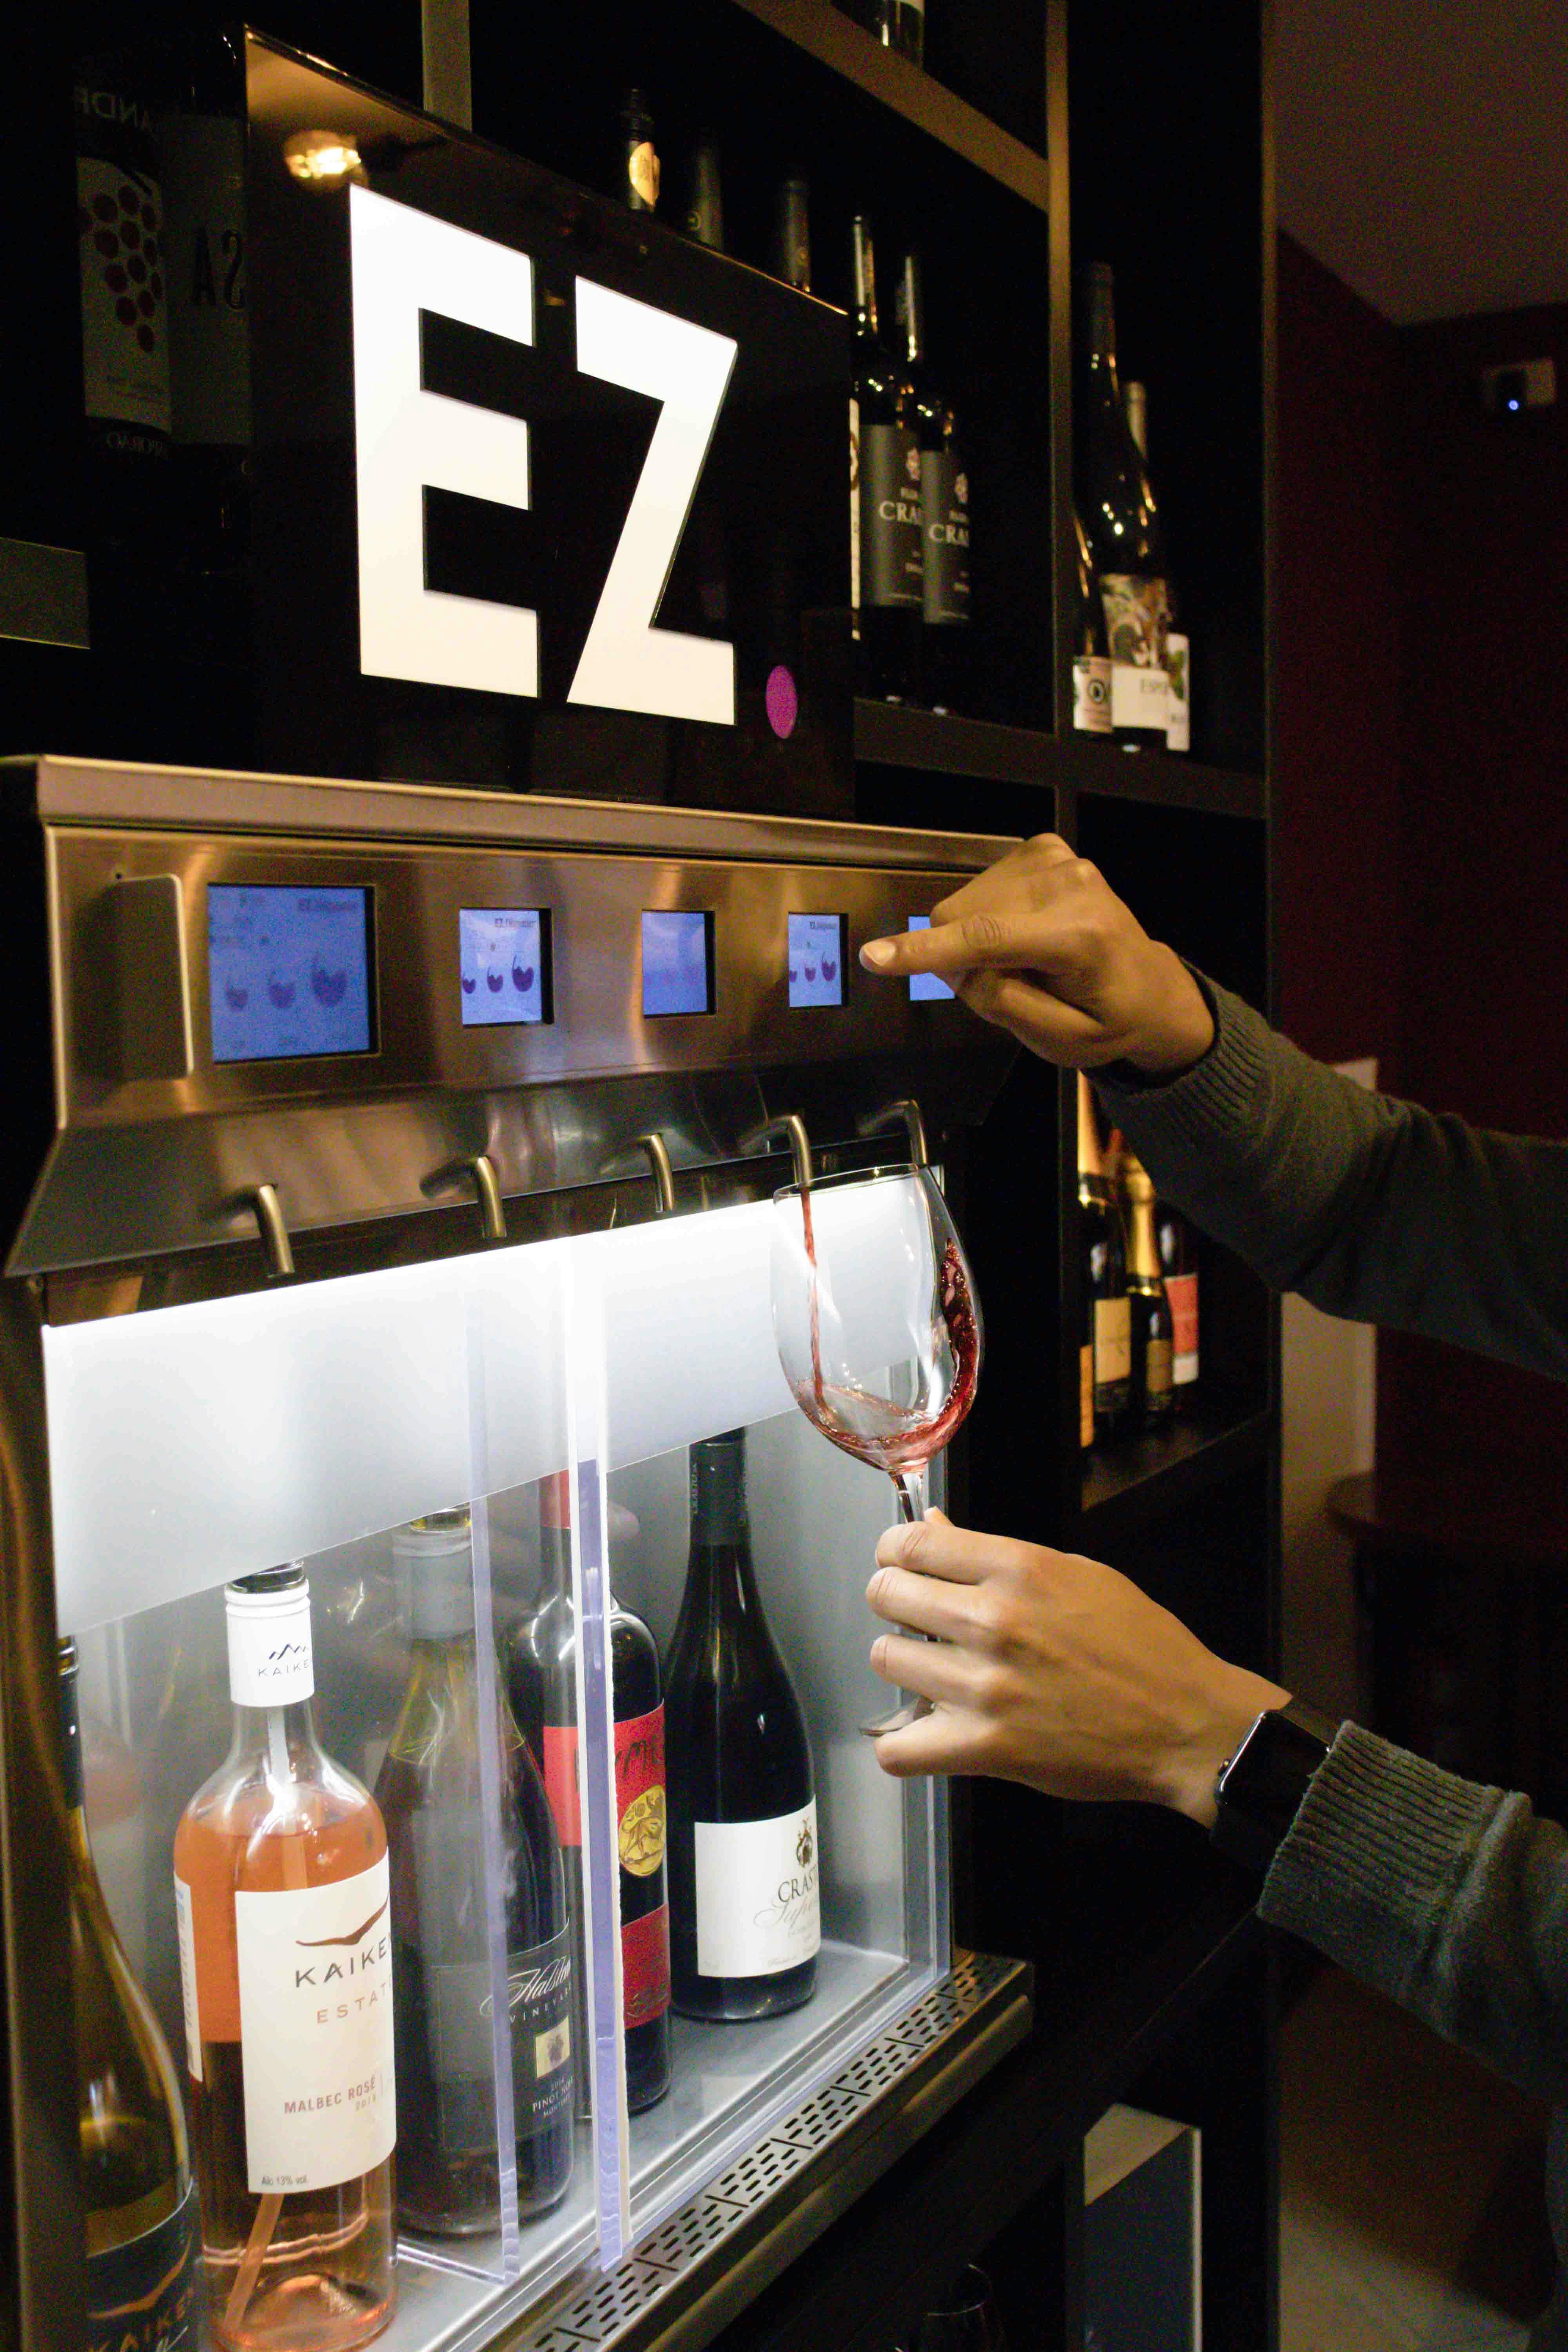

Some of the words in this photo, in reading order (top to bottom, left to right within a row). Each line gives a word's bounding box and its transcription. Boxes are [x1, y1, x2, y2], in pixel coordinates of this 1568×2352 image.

[296, 1931, 391, 1987] KAIKE
[284, 2092, 342, 2114] MALBEC
[348, 2074, 376, 2100] ROSÉ
[532, 2091, 558, 2112] PINOT
